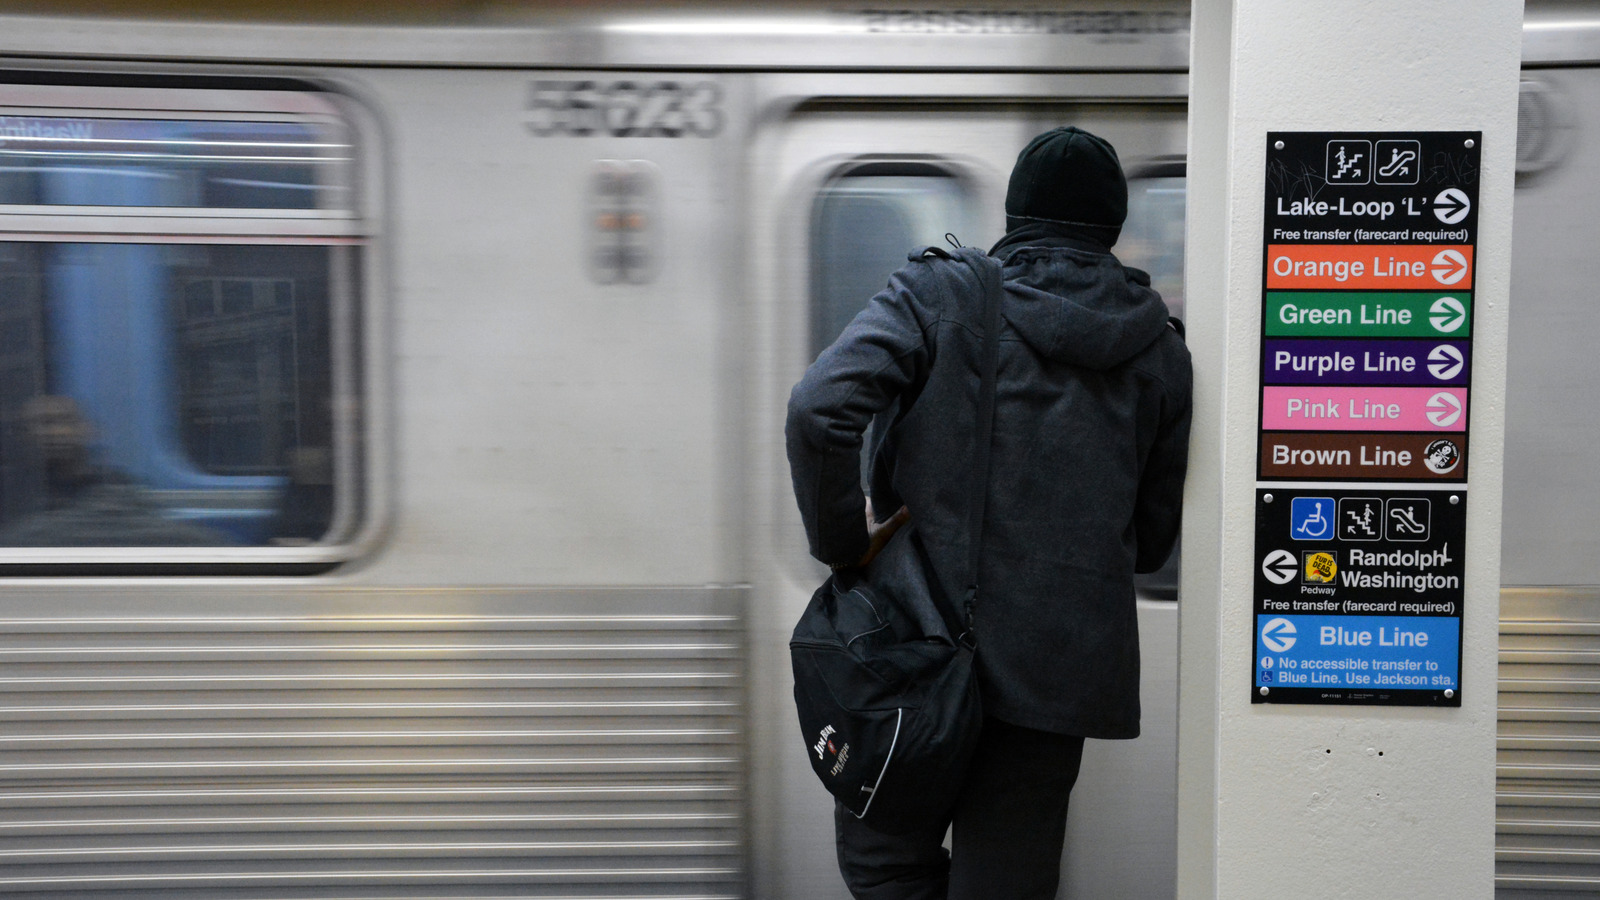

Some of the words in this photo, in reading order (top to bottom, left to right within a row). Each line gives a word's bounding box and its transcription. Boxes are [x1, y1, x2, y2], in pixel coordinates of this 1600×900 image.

[1277, 197, 1395, 220] Lake-Loop
[1273, 229, 1300, 240] Free
[1303, 229, 1351, 240] transfer
[1354, 229, 1409, 242] (farecard
[1412, 229, 1468, 242] required)
[1273, 256, 1365, 282] Orange
[1373, 256, 1426, 277] Line
[1279, 304, 1352, 325] Green
[1360, 305, 1412, 325] Line
[1275, 351, 1355, 377] Purple
[1364, 352, 1416, 372] Line
[1287, 398, 1341, 419] Pink
[1349, 399, 1401, 419] Line
[1272, 444, 1351, 466] Brown
[1360, 446, 1412, 466] Line
[1312, 561, 1331, 573] DEAD
[1315, 555, 1328, 564] FUR
[1301, 586, 1336, 596] Pedway
[1341, 570, 1459, 593] Washington
[1263, 599, 1290, 611] Free
[1292, 600, 1340, 612] transfer
[1342, 601, 1397, 614] (farecard
[1399, 602, 1455, 615] required)
[1320, 626, 1372, 646] Blue
[1379, 627, 1429, 647] Line
[1279, 657, 1297, 669] No
[1300, 658, 1370, 670] accessible
[1372, 659, 1423, 671] transfer
[1425, 660, 1438, 671] to
[1279, 672, 1308, 684] Blue
[1311, 672, 1342, 684] Line.
[1345, 673, 1371, 684] Use
[1373, 673, 1428, 685] Jackson
[1431, 674, 1455, 686] sta.
